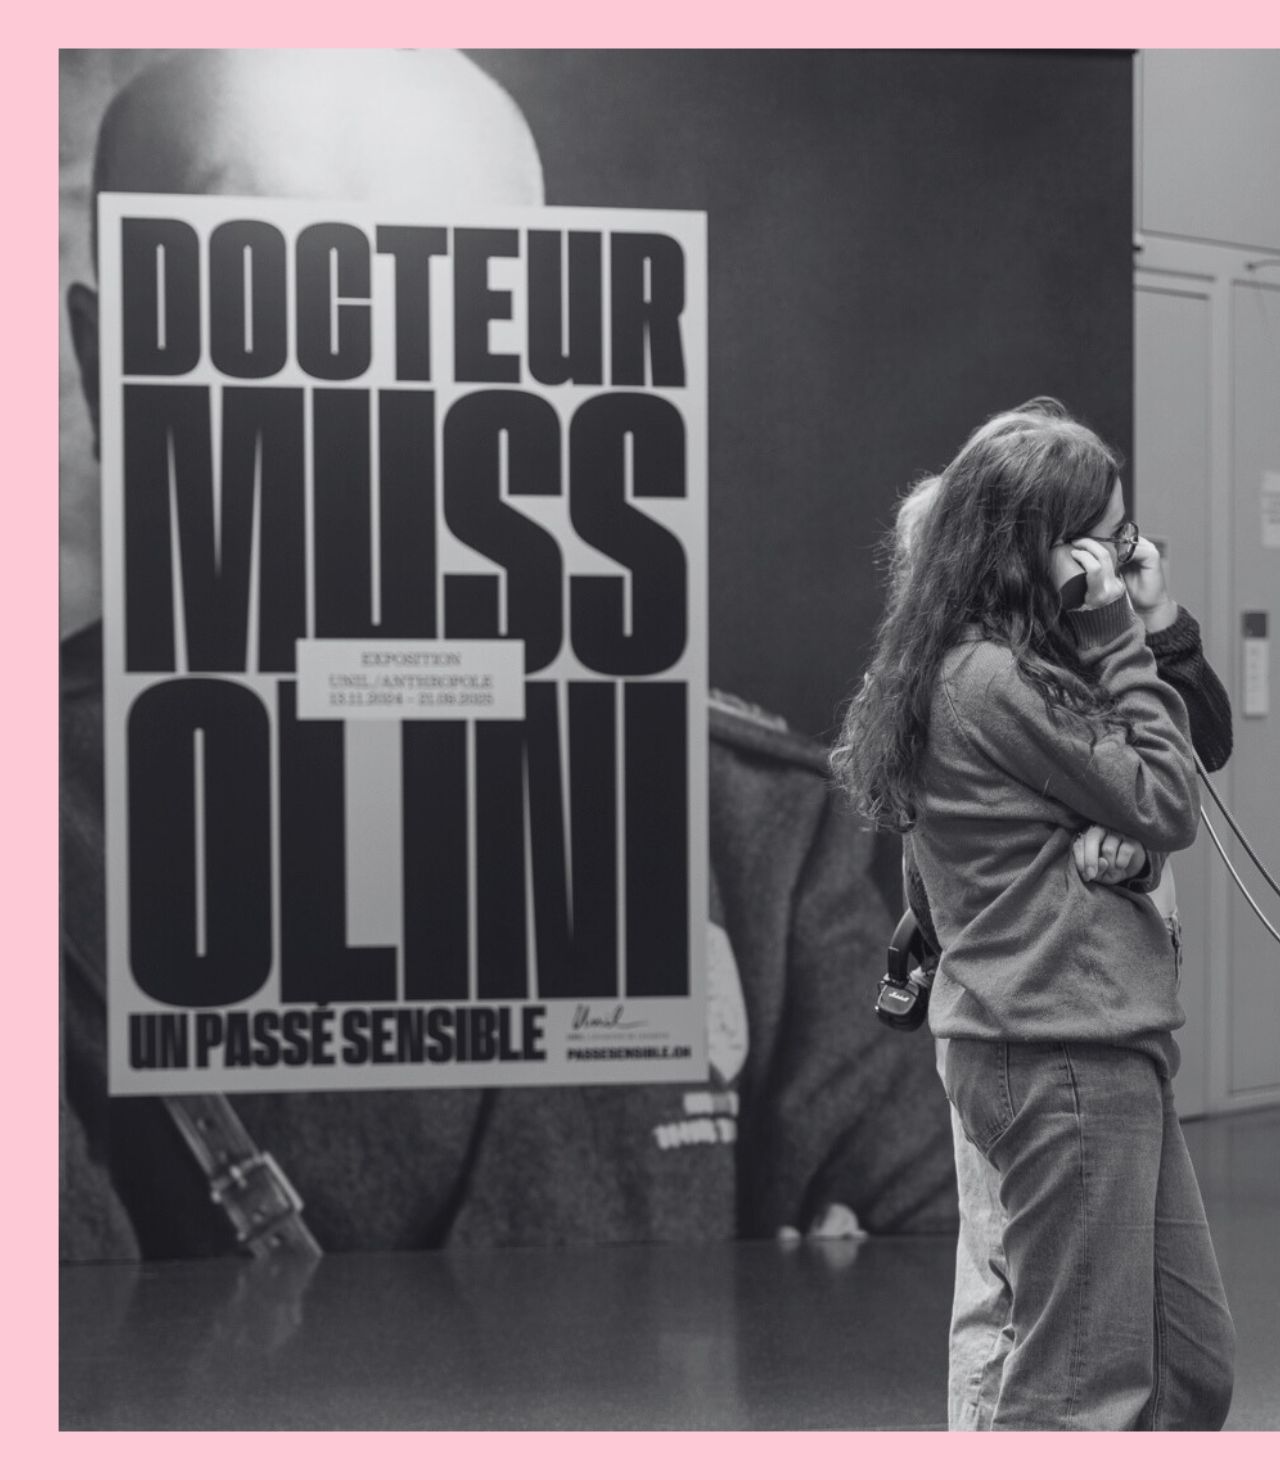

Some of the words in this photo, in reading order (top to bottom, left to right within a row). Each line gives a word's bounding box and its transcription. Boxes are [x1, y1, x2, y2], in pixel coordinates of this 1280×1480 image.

[121, 216, 687, 388] DOCTEUR
[122, 382, 689, 676] MUSS
[360, 651, 462, 666] EXPOSITION
[125, 678, 690, 1008] OLINI
[129, 1012, 189, 1071] UN
[195, 1002, 336, 1069] PASSÉ
[342, 1006, 547, 1065] SENSIBLE
